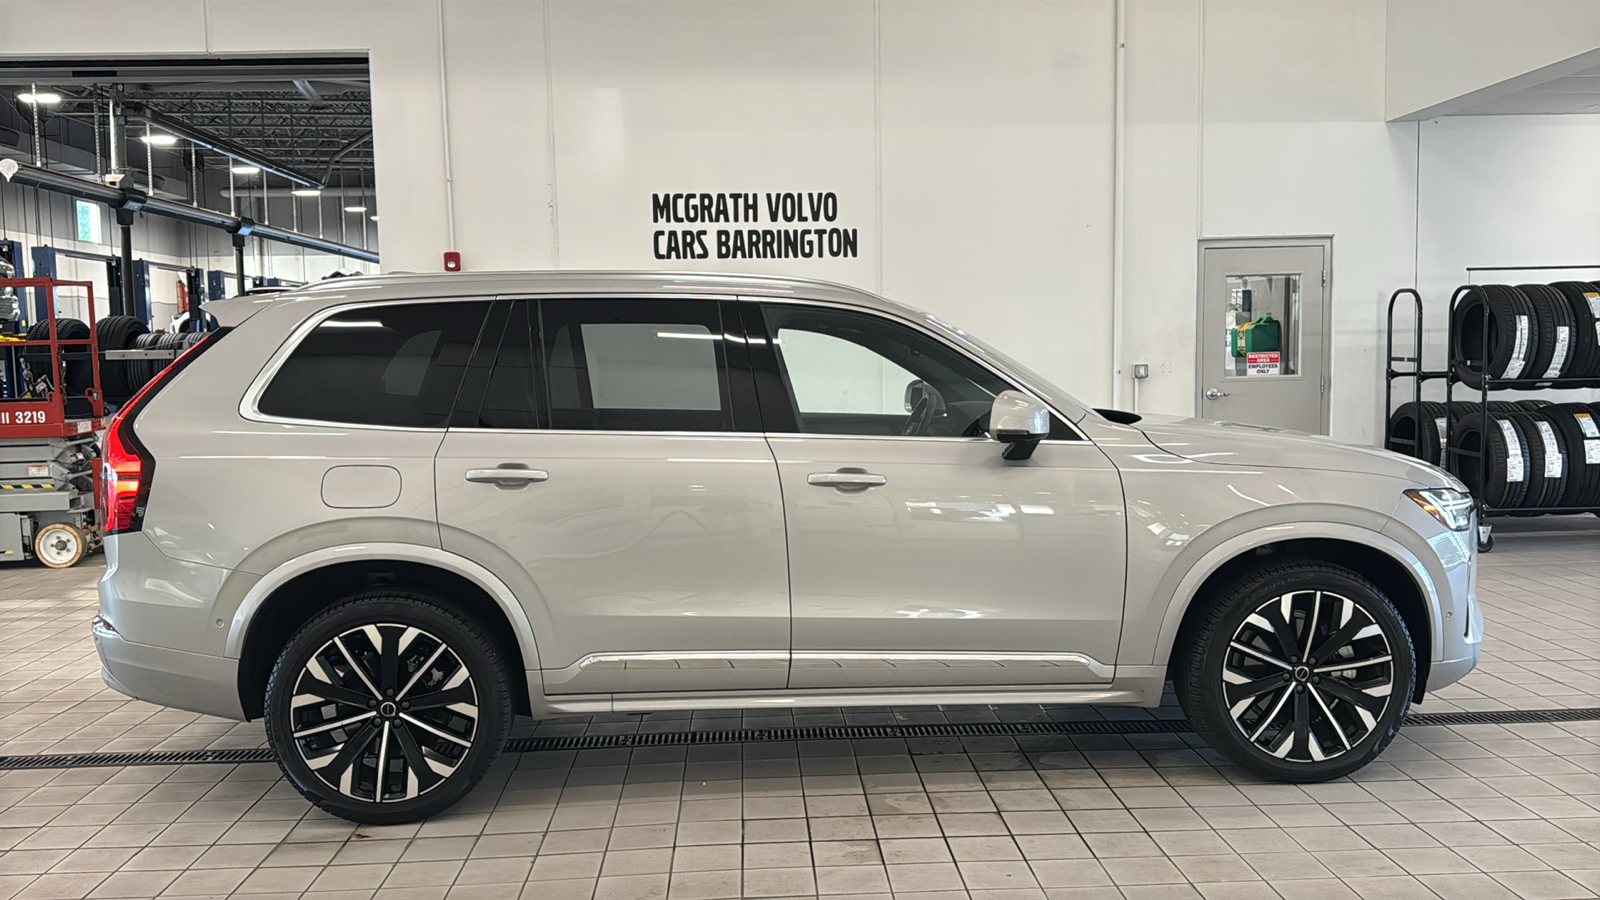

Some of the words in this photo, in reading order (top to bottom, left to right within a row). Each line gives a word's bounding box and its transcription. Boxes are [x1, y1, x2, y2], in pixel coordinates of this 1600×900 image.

[652, 192, 758, 223] MCGRATH
[766, 192, 837, 222] VOLVO
[653, 229, 709, 260] CARS
[716, 228, 858, 259] BARRINGTON
[15, 410, 46, 424] 3219
